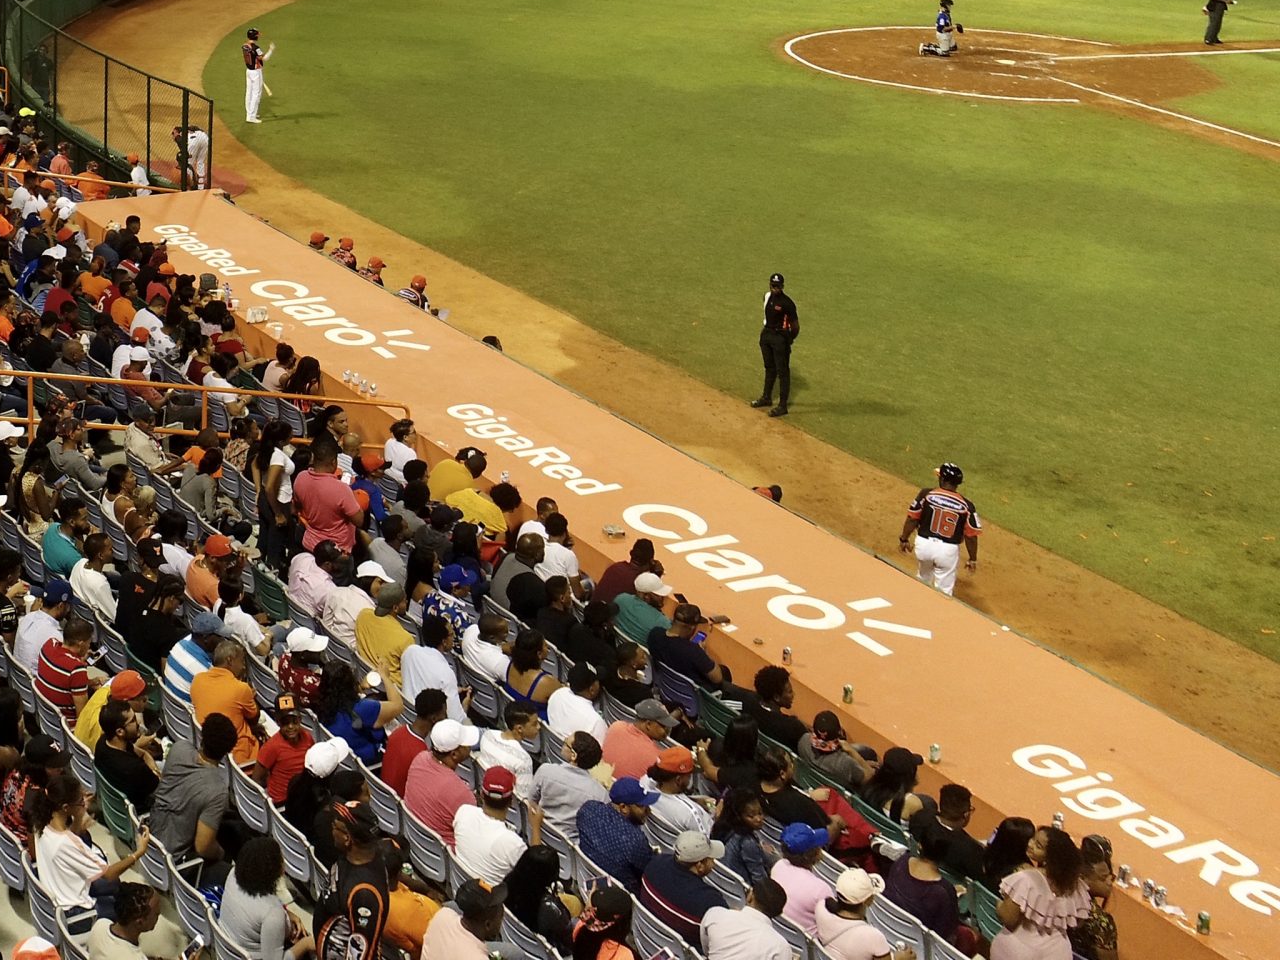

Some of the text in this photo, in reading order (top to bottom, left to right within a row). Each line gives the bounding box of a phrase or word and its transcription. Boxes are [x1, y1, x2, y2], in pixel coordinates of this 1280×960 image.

[153, 224, 376, 346] GigaRed Claro
[446, 403, 847, 630] GigaRed Claro
[930, 507, 959, 538] 16
